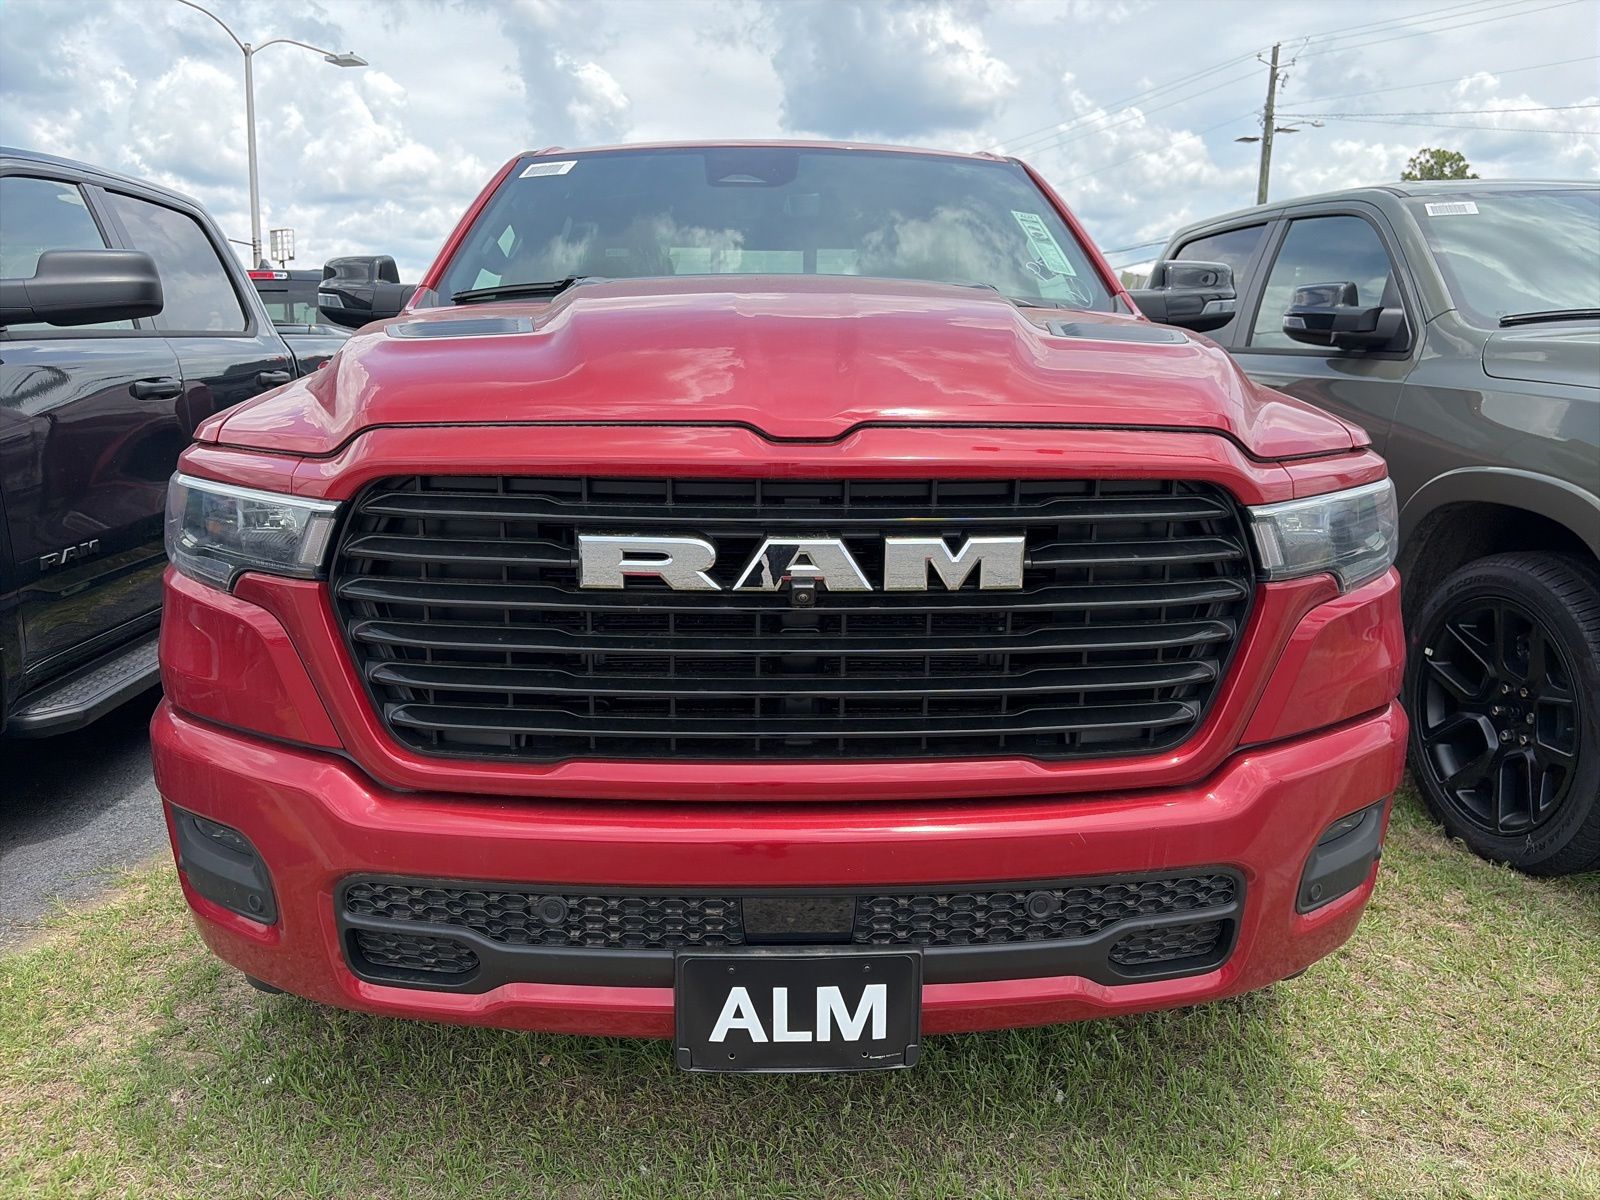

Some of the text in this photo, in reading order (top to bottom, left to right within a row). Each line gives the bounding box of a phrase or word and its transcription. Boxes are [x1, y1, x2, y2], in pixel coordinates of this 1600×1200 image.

[39, 539, 101, 571] RAM
[578, 535, 1025, 591] RAM
[708, 983, 887, 1043] ALM
